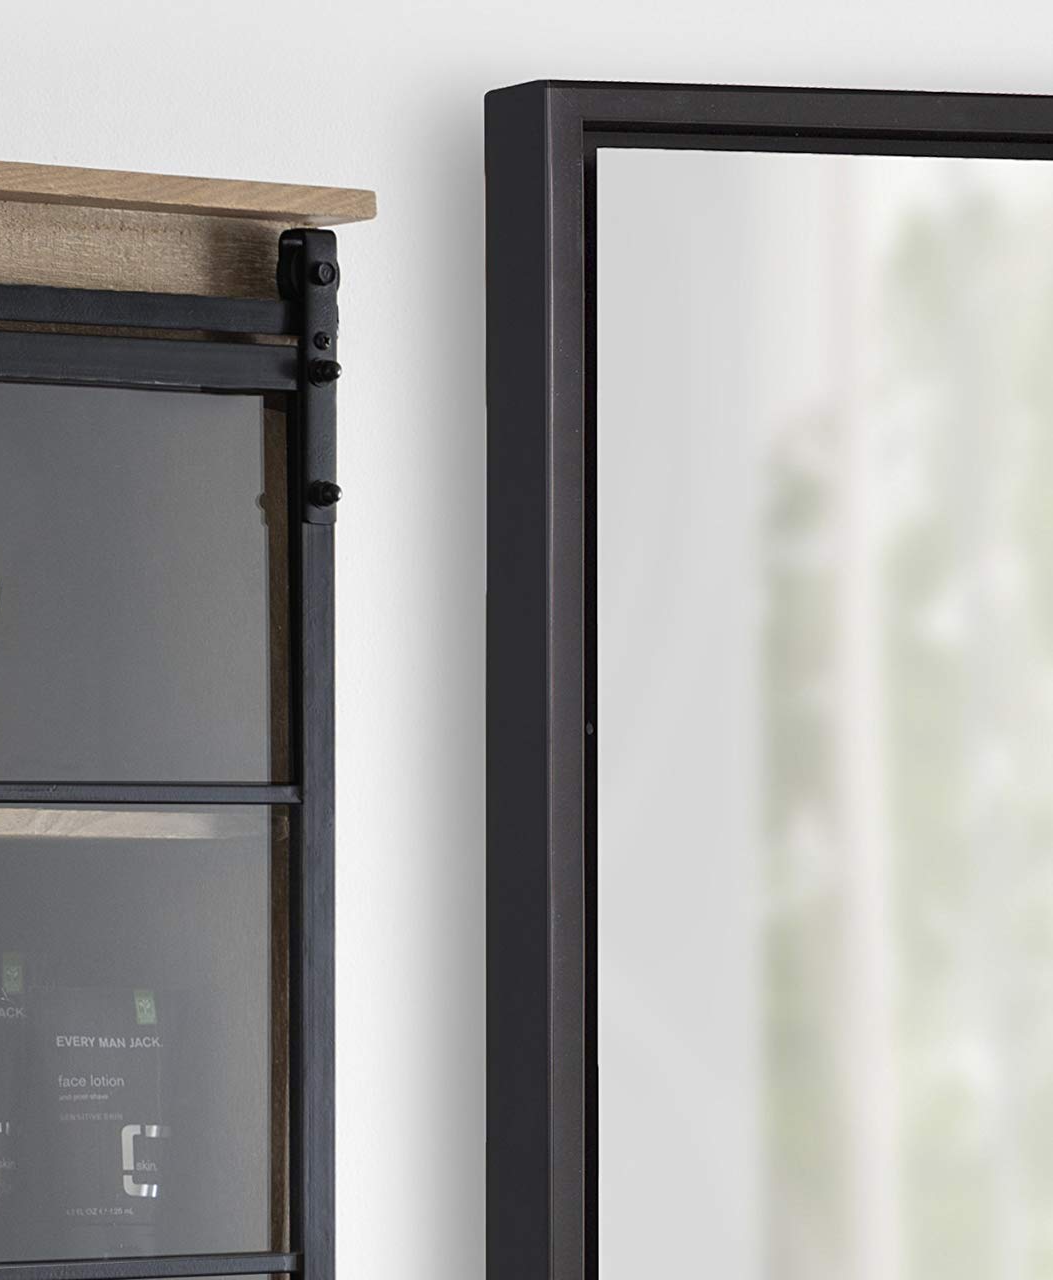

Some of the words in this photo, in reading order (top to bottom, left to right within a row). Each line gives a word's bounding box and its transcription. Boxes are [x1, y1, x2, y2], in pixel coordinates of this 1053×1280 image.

[56, 1035, 95, 1047] EVERY
[98, 1036, 126, 1048] MAN
[58, 1074, 87, 1088] face
[90, 1073, 125, 1088] lotion
